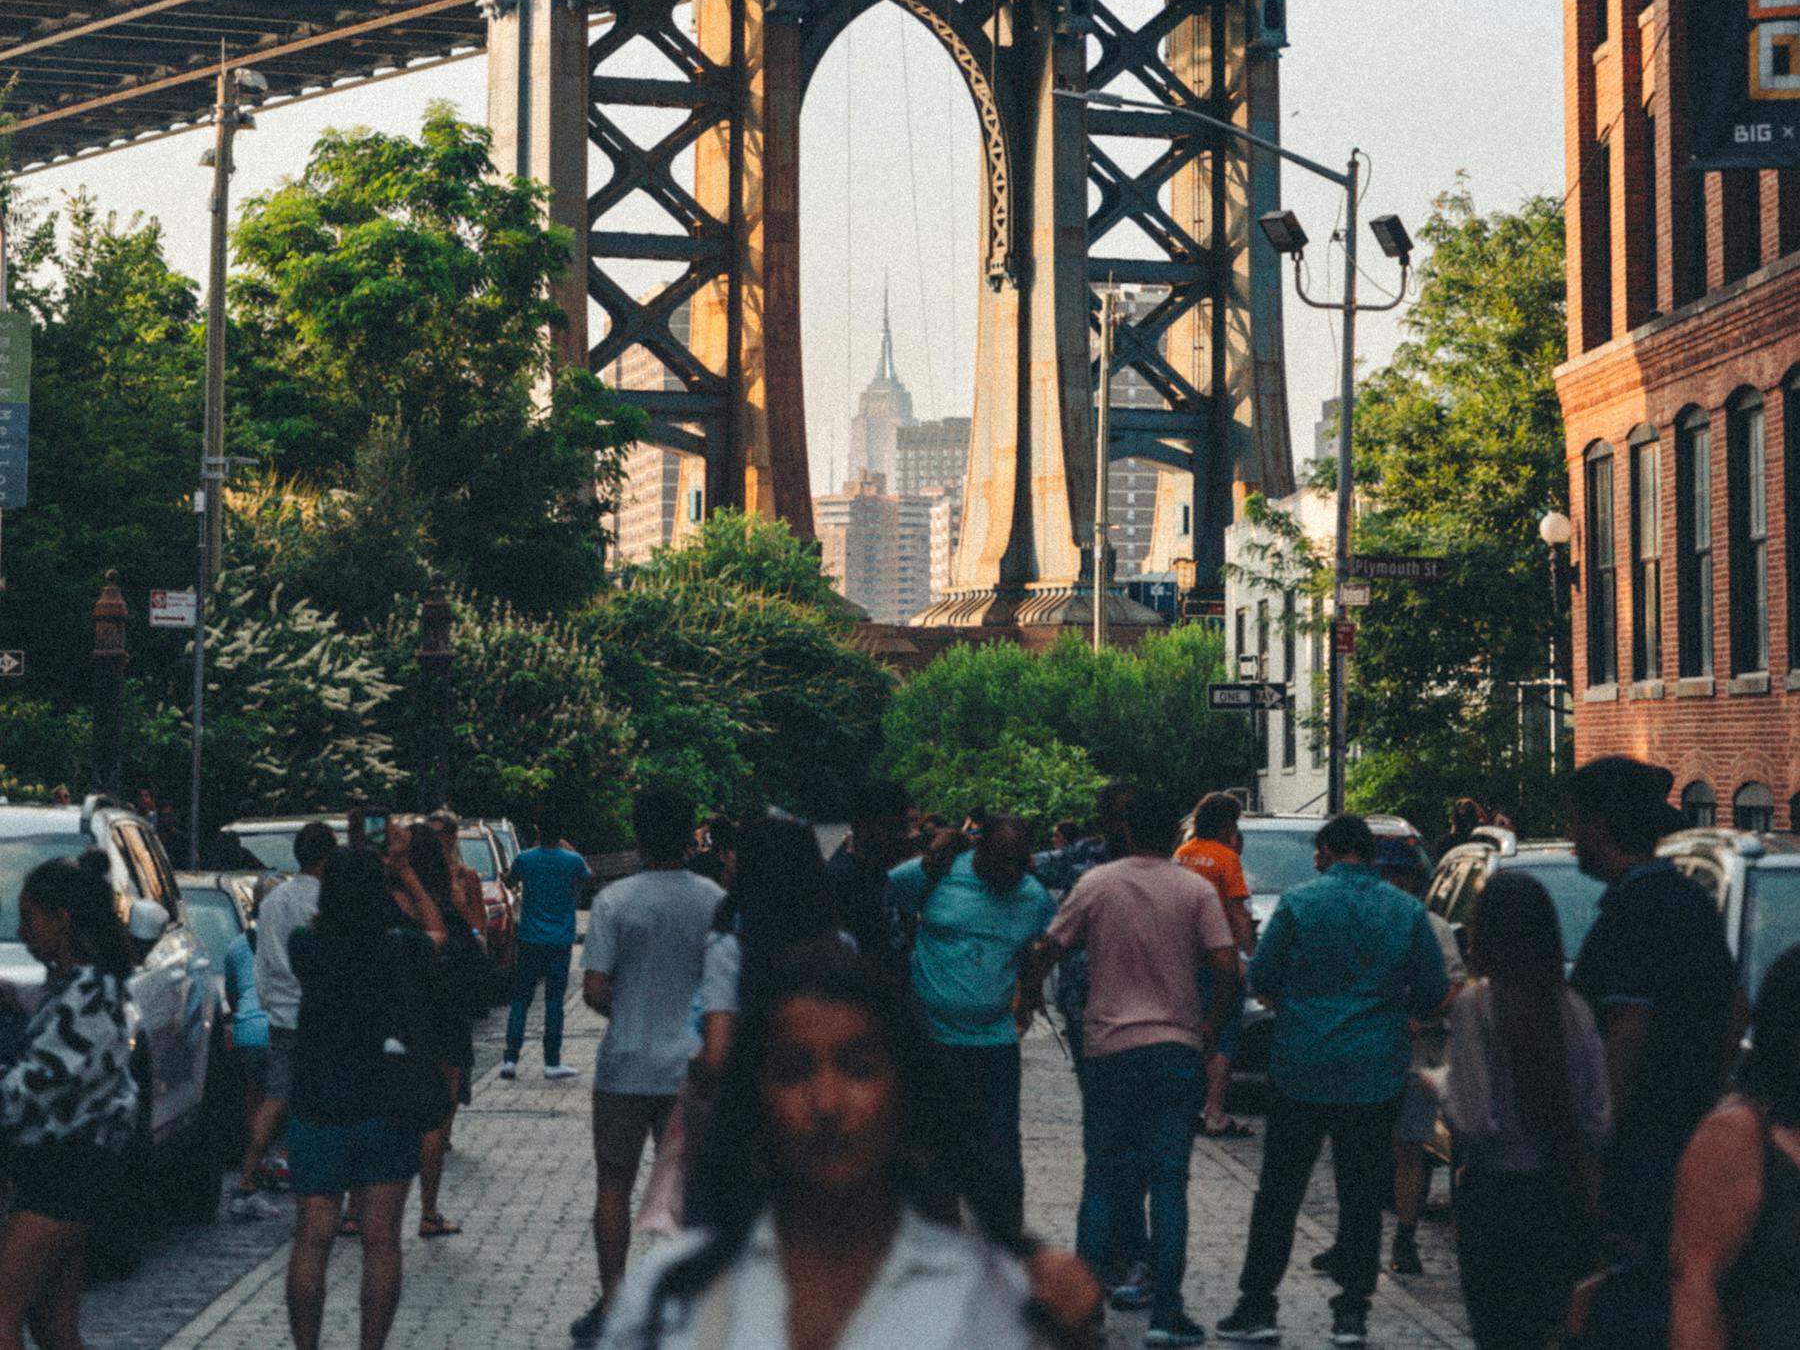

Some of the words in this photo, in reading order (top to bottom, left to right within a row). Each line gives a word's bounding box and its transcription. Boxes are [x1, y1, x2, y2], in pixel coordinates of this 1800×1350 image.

[1734, 123, 1772, 142] BIG
[1355, 559, 1420, 577] Plymouth
[1424, 561, 1437, 577] St
[1219, 691, 1242, 703] ONE
